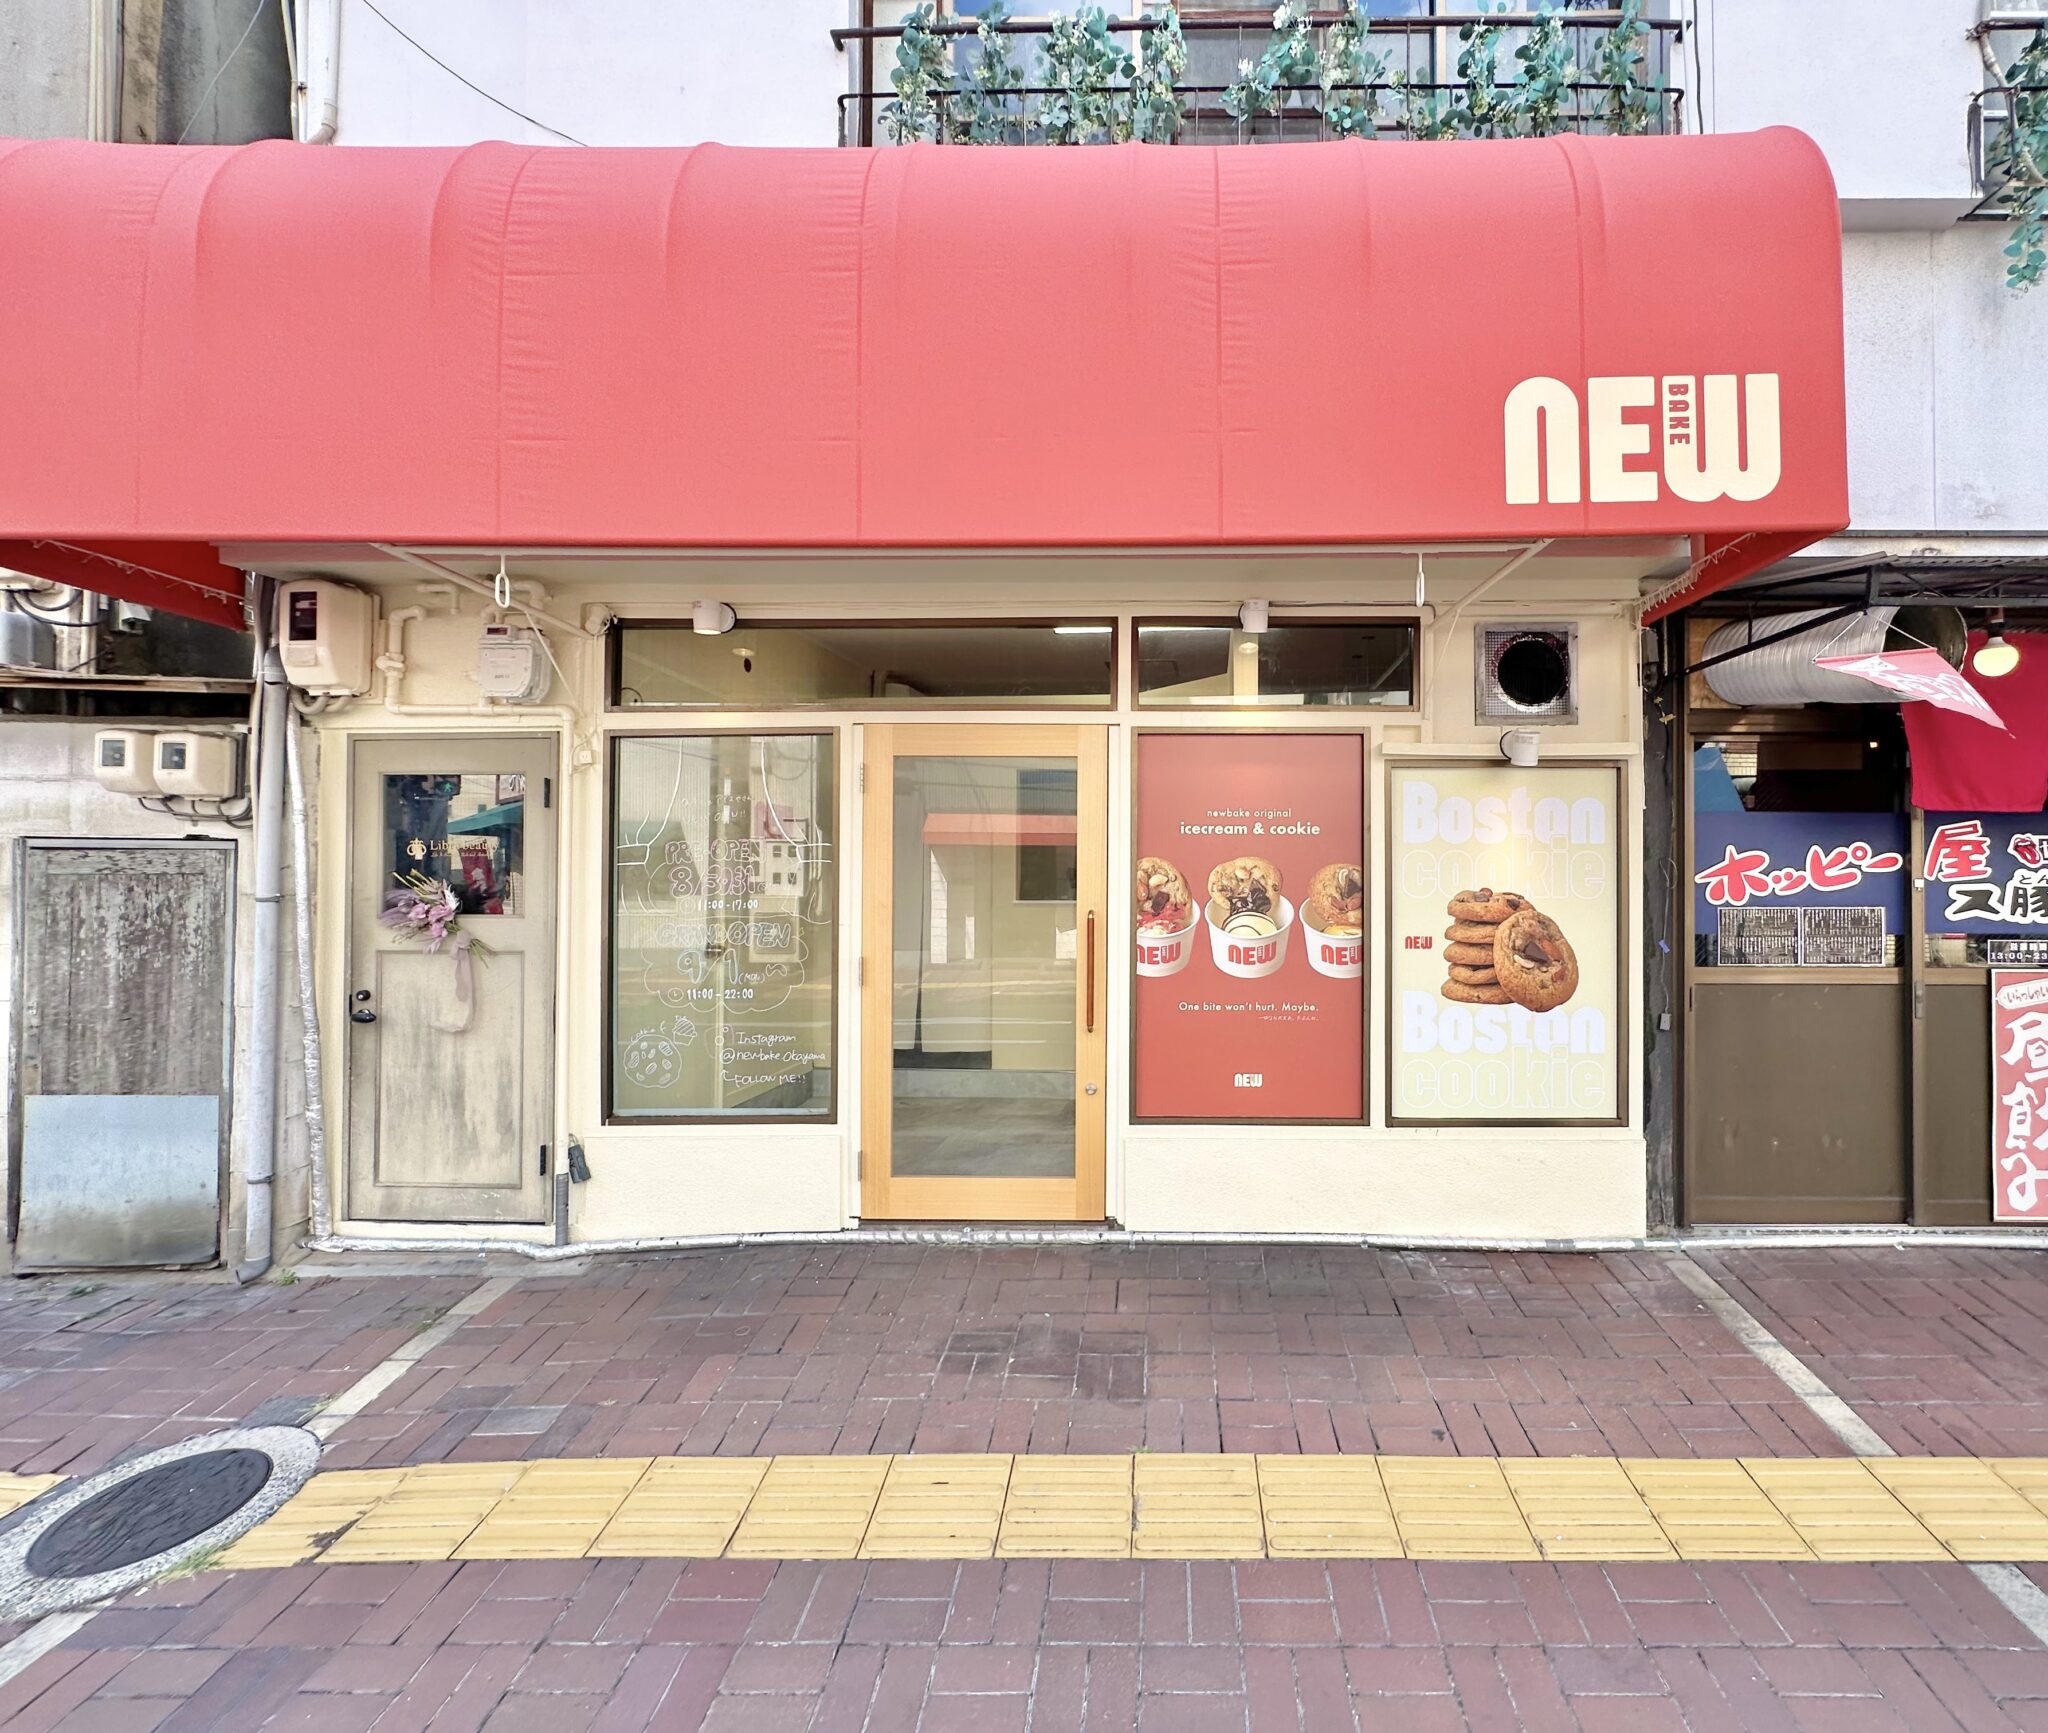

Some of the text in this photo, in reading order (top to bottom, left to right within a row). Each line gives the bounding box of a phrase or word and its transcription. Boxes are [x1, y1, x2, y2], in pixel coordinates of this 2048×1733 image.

[1668, 383, 1691, 445] BAKE
[1180, 822, 1321, 835] icecream & cookie
[1207, 808, 1292, 819] newbake original
[1402, 781, 1606, 845] Boston
[1402, 834, 1606, 899] cookie
[1696, 820, 1992, 906] ホッピー 屋
[727, 921, 791, 948] OPEN
[1179, 1001, 1200, 1011] One
[1203, 1001, 1222, 1011] bite
[1255, 1001, 1278, 1011] hurt.
[1282, 1001, 1319, 1014] Maybe.
[736, 1032, 796, 1047] Instagram
[1402, 1043, 1606, 1109] cookie
